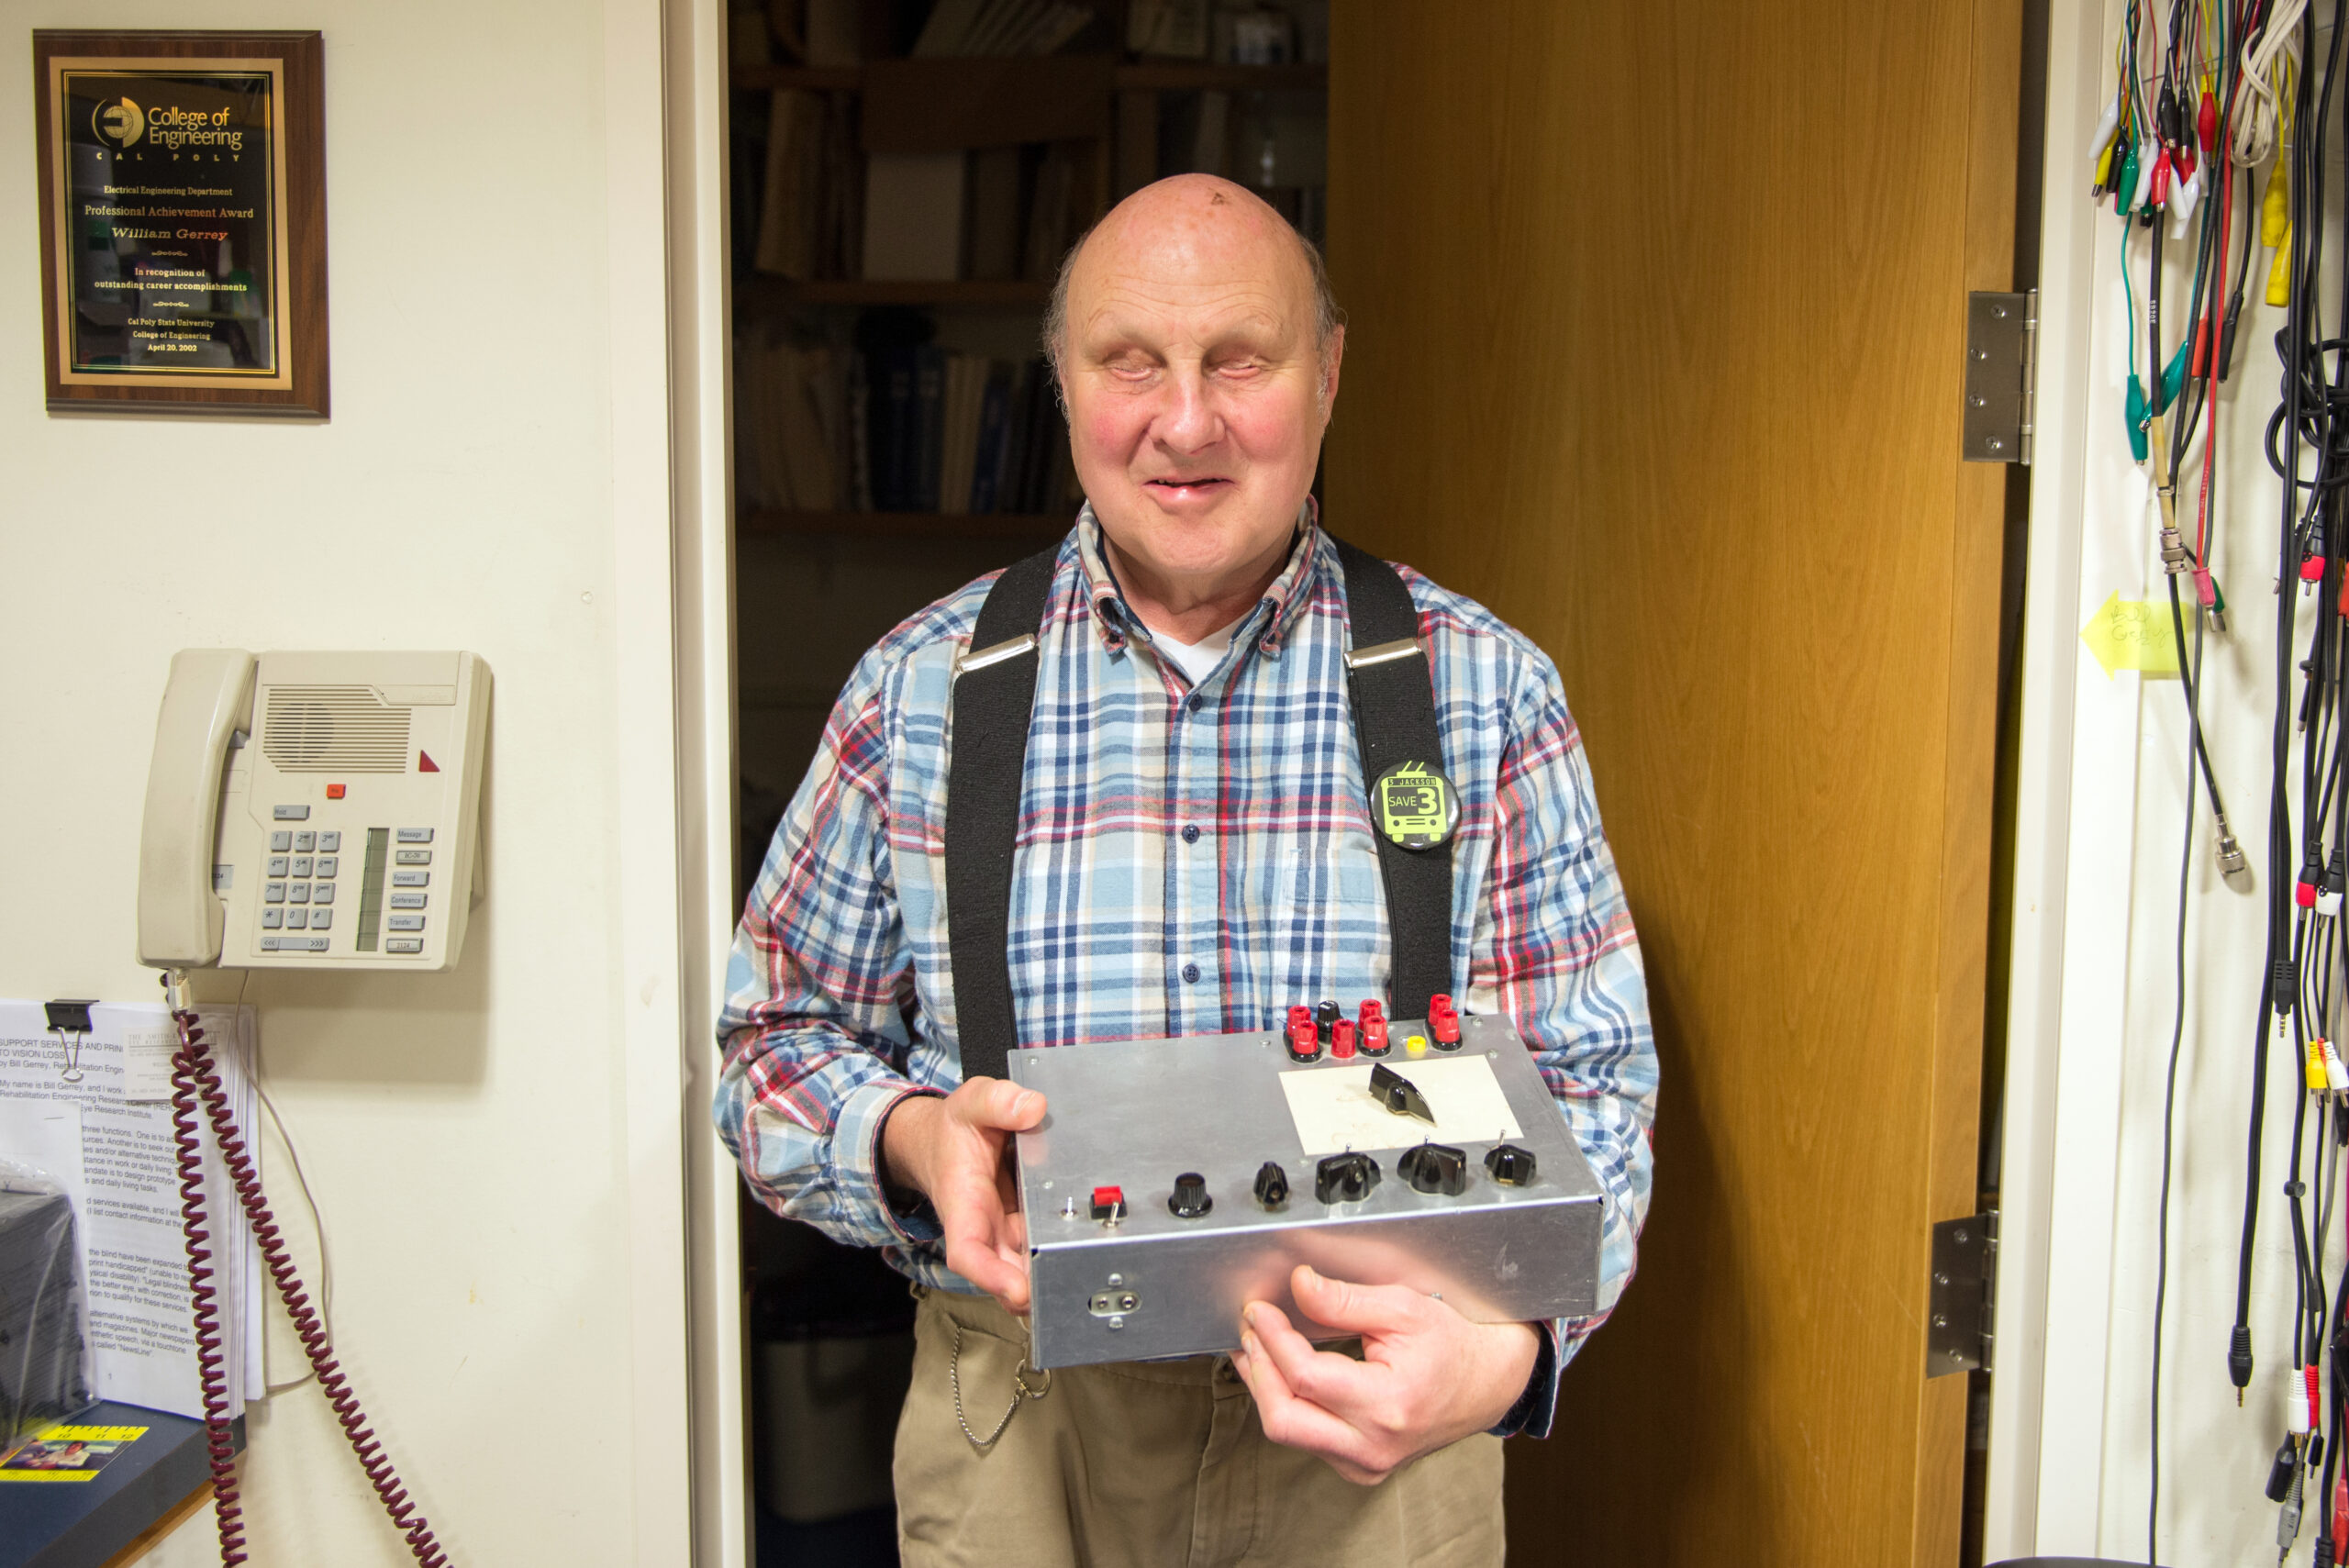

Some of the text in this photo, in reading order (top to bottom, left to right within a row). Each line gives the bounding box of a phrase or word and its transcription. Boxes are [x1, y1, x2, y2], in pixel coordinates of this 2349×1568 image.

[149, 106, 229, 131] College of
[150, 127, 242, 150] Engineering
[96, 152, 142, 161] CAL
[105, 185, 232, 197] Electrical Engineering Department
[85, 206, 254, 218] Professional Achievement Award
[112, 228, 228, 241] William Gerrey
[135, 268, 143, 276] In
[146, 269, 195, 278] recognition
[95, 281, 144, 290] outstanding
[174, 283, 247, 292] accomplishments
[140, 318, 156, 327] Poly
[177, 319, 215, 328] University
[133, 331, 158, 339] College
[169, 332, 210, 340] Engineering
[148, 344, 165, 352] April
[1389, 787, 1438, 815] SAVE 3
[398, 829, 422, 839] Message
[0, 1039, 103, 1051] SUPPORT AND
[12, 1050, 40, 1058] VISION
[43, 1051, 65, 1059] LOSS
[44, 1081, 55, 1089] Bill
[0, 1090, 129, 1106] Rehabilitation Engineering Research
[95, 1105, 126, 1115] Research
[137, 1130, 150, 1140] One
[108, 1138, 132, 1147] Another
[95, 1147, 150, 1161] and/or alternative
[139, 1162, 154, 1172] daily
[125, 1171, 145, 1182] design
[147, 1174, 175, 1186] prototype
[106, 1179, 121, 1189] daily
[123, 1180, 139, 1191] living
[94, 1198, 120, 1207] services
[94, 1207, 104, 1216] list
[105, 1209, 128, 1219] contact
[130, 1213, 164, 1225] information
[173, 1219, 183, 1229] the
[102, 1250, 117, 1259] blind
[119, 1251, 134, 1261] have
[136, 1255, 151, 1263] been
[152, 1259, 183, 1270] expanded
[150, 1268, 173, 1279] (unable
[173, 1272, 180, 1280] to
[103, 1280, 121, 1288] better
[112, 1293, 133, 1303] qualify
[144, 1297, 161, 1307] these
[90, 1310, 124, 1321] alternative
[126, 1315, 150, 1326] systems
[151, 1320, 159, 1329] by
[161, 1322, 178, 1331] which
[141, 1328, 158, 1338] Major
[160, 1332, 195, 1345] newspapers
[96, 1341, 117, 1350] called
[157, 1341, 186, 1354] touchtone
